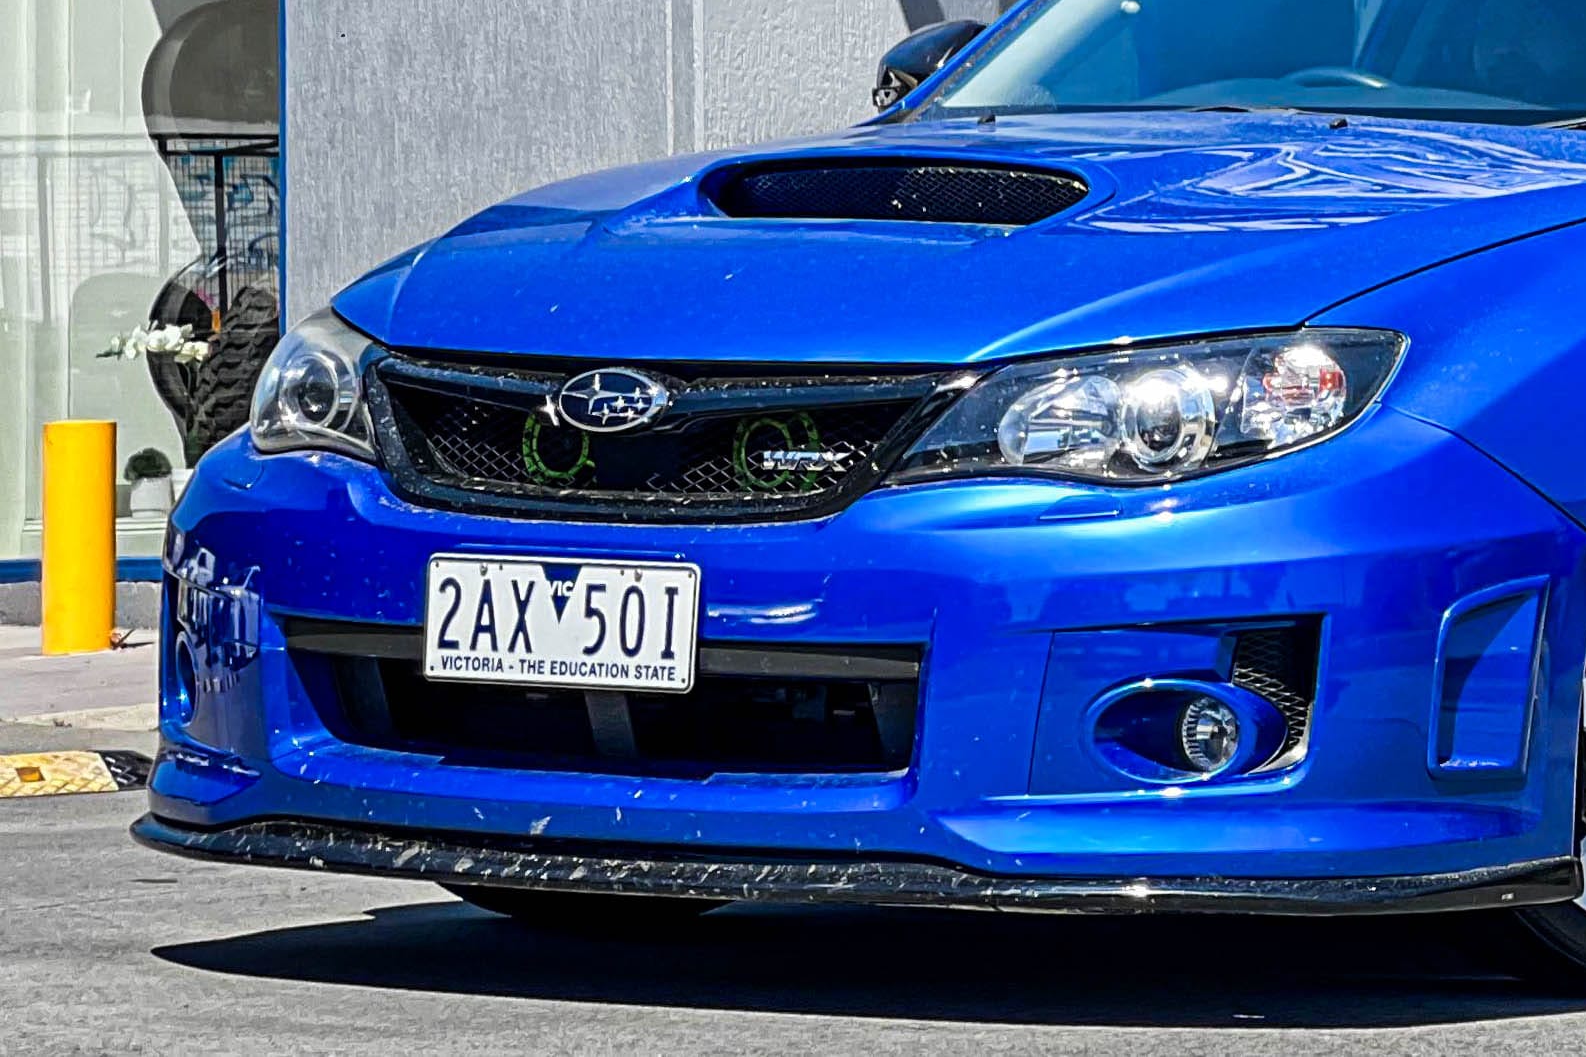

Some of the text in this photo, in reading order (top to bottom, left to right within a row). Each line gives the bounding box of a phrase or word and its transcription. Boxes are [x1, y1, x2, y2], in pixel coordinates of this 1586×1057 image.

[437, 576, 535, 654] 2AX
[441, 655, 504, 673] VICTORIA
[519, 659, 545, 675] THE
[550, 660, 629, 679] EDUCATION
[634, 665, 676, 681] STATE
